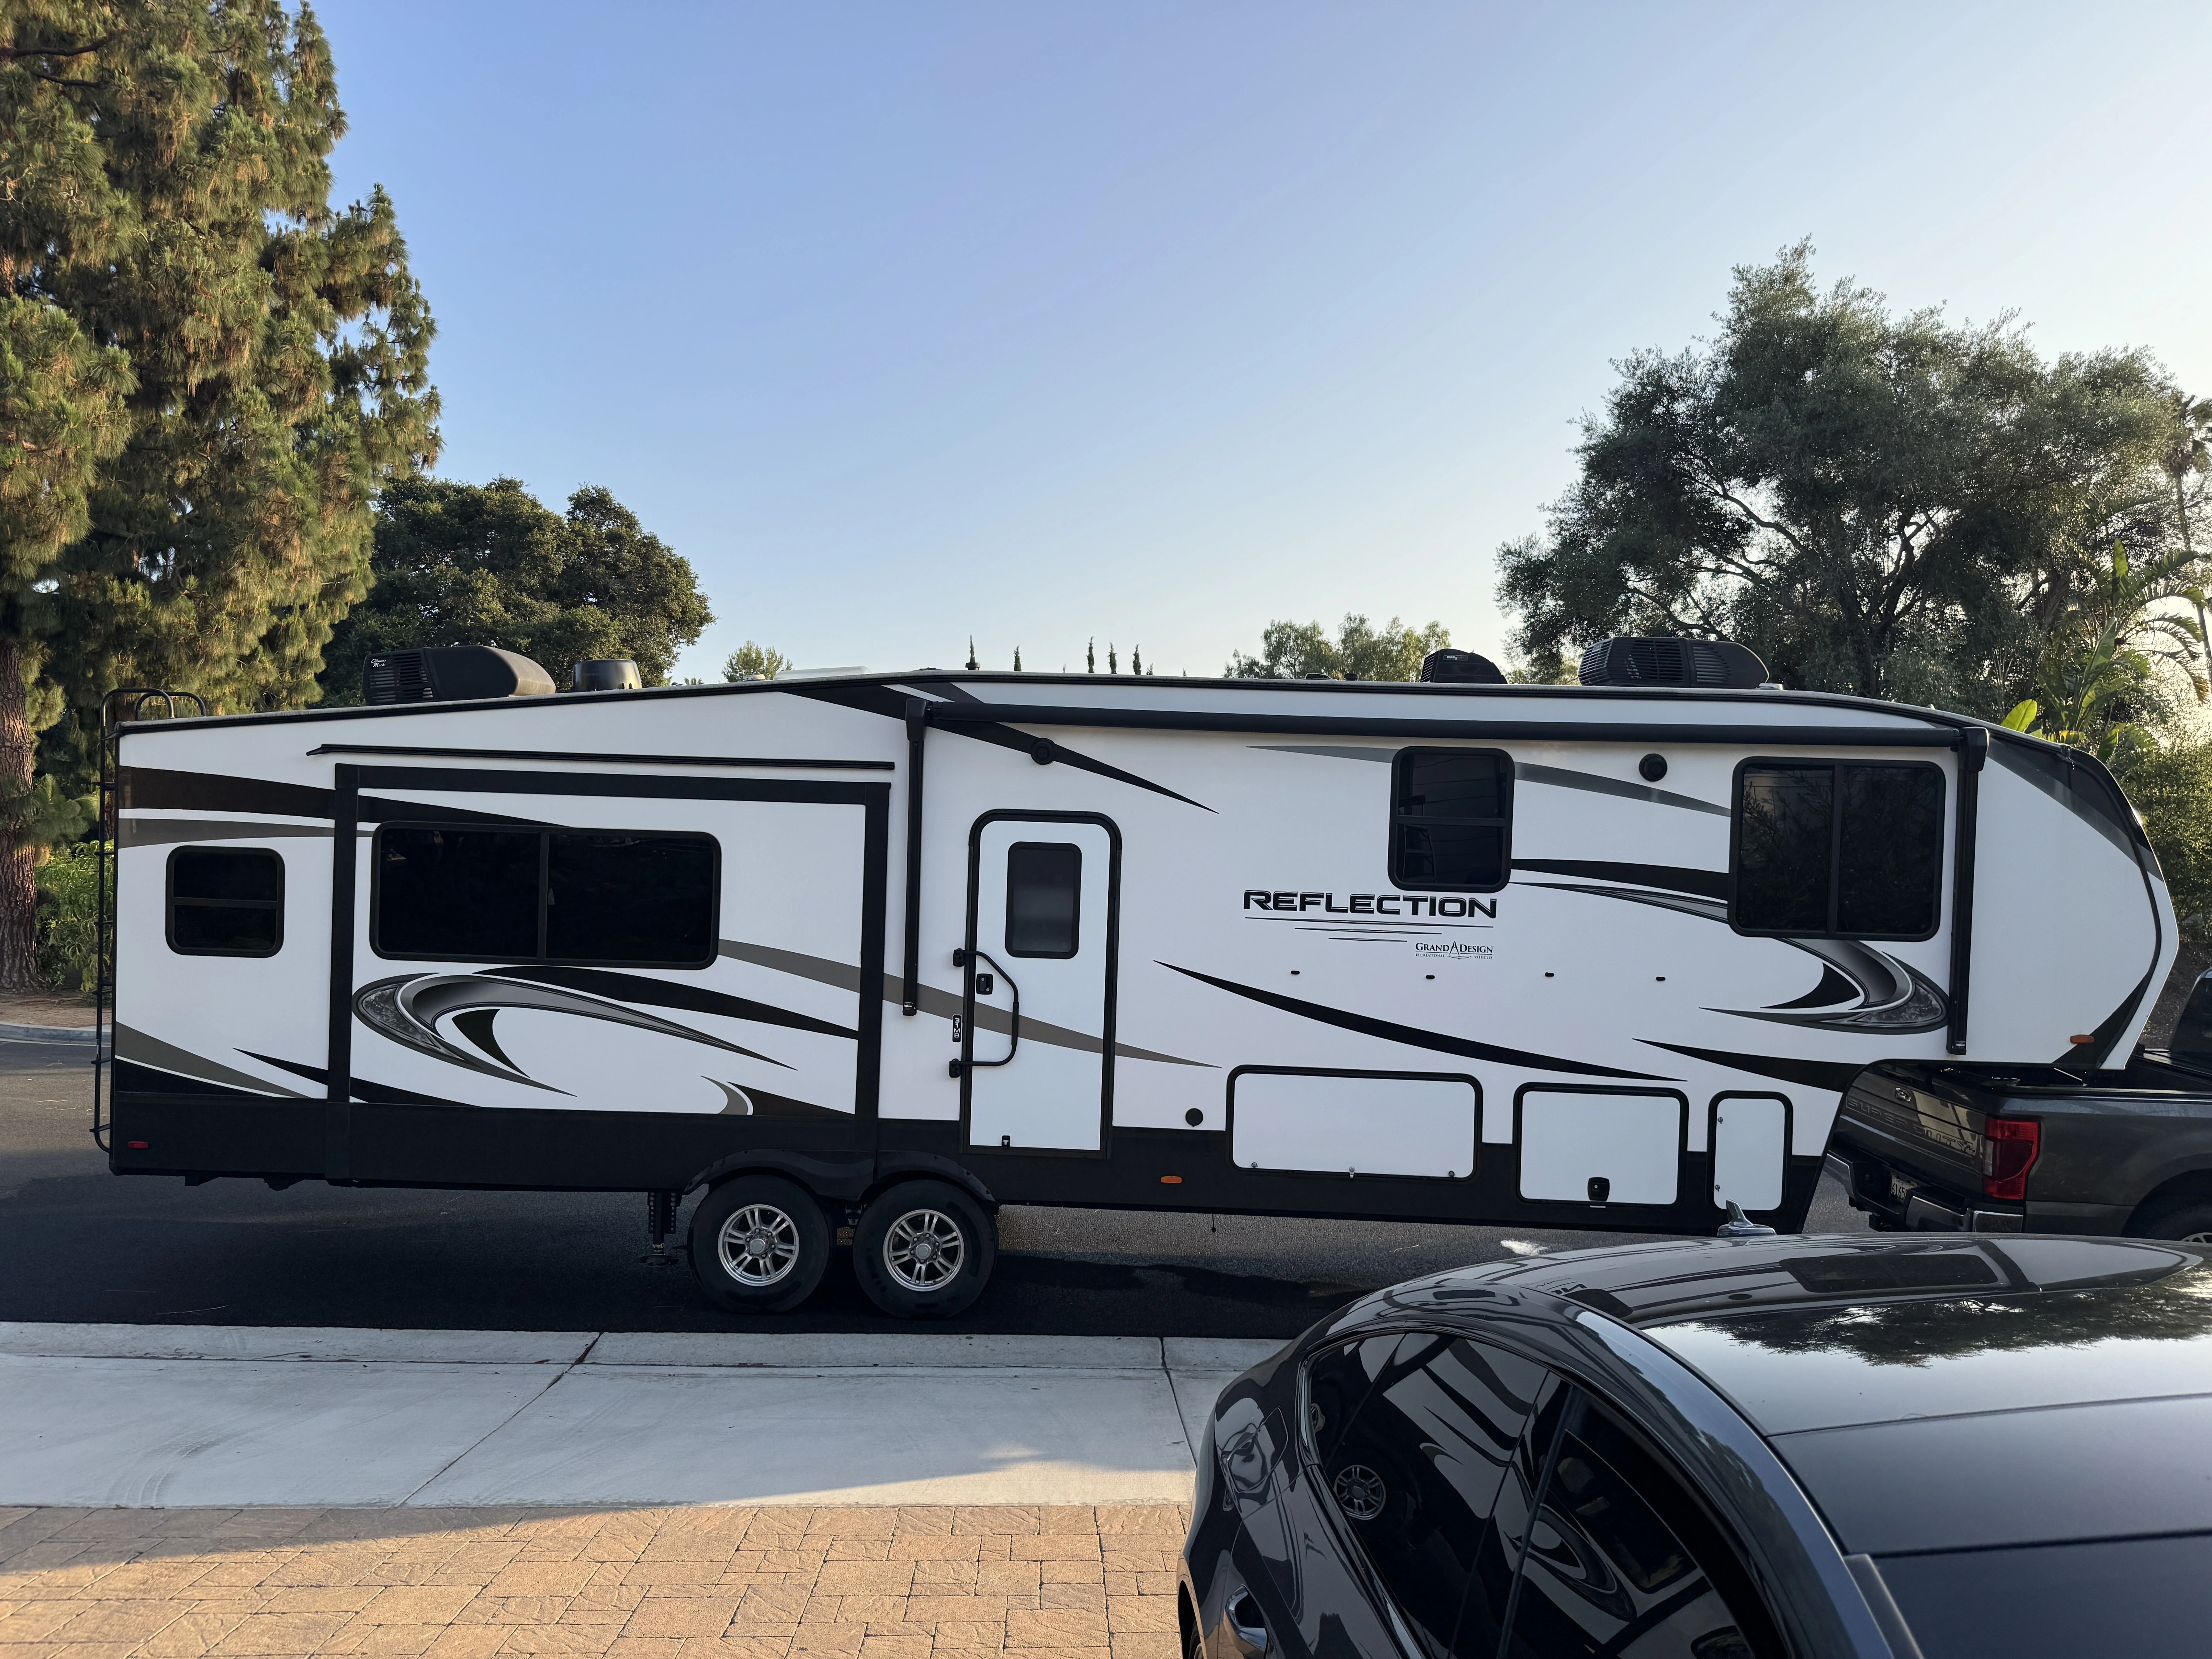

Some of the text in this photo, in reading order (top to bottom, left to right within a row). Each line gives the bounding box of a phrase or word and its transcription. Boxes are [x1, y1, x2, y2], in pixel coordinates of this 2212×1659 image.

[1243, 890, 1497, 919] REFLECTION
[1415, 943, 1493, 953] GRAND DESIGN
[1848, 1098, 1968, 1153] SUPER DUTY
